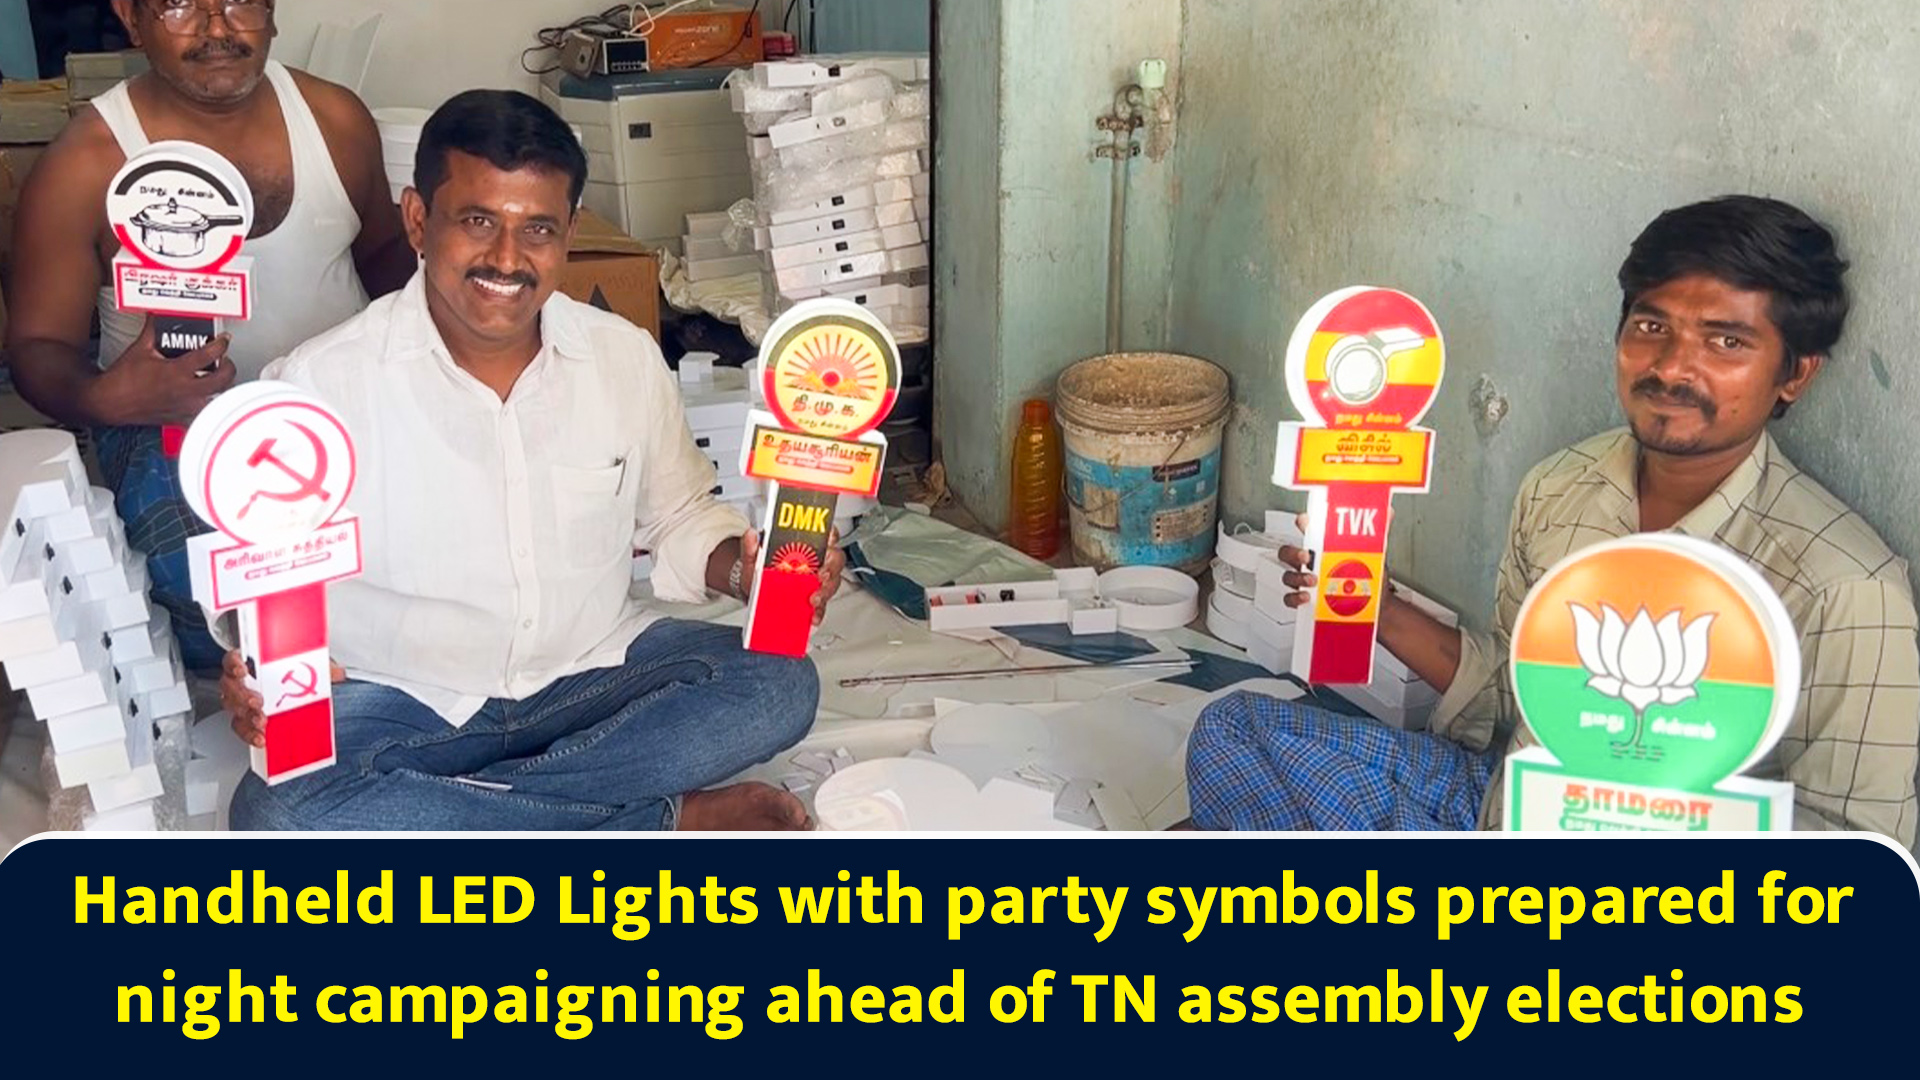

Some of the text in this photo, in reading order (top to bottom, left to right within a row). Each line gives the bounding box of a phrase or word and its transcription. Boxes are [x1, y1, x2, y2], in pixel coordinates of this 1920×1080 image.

[161, 333, 208, 350] AMMK
[763, 434, 872, 463] உதயசூரியன்
[778, 502, 830, 534] DMK
[1335, 507, 1378, 536] TVK
[1562, 783, 1713, 831] தாமரை
